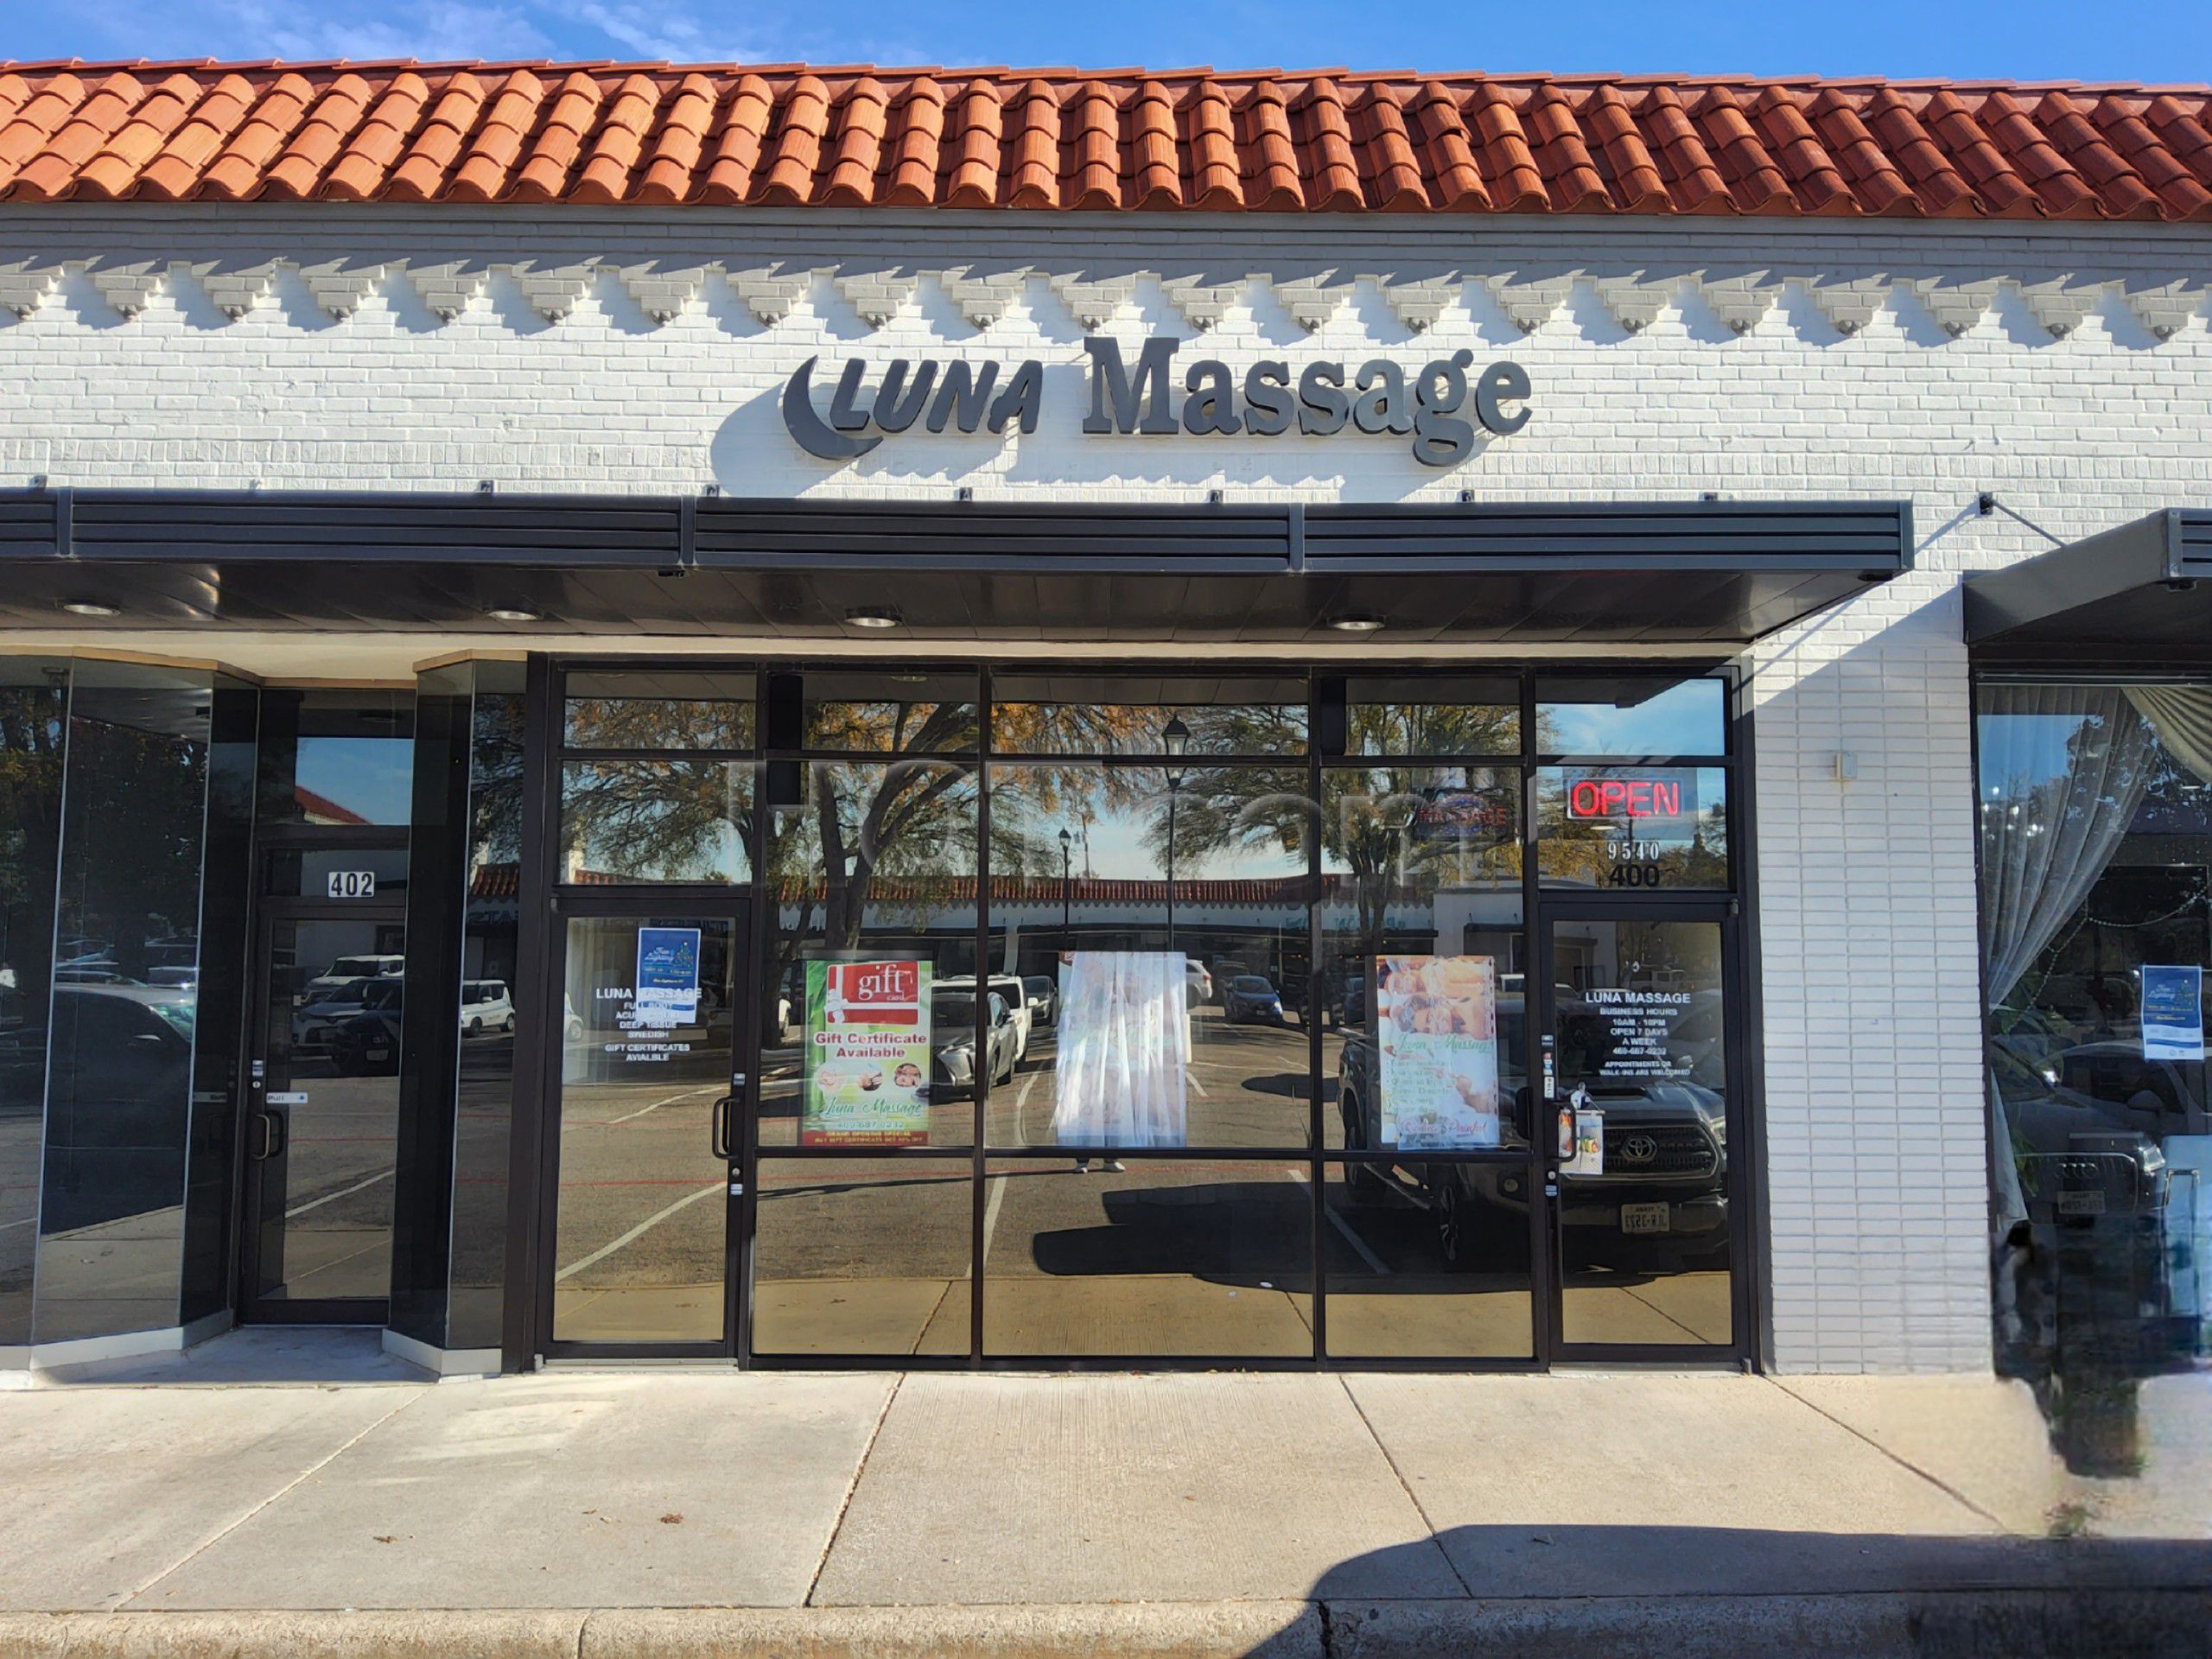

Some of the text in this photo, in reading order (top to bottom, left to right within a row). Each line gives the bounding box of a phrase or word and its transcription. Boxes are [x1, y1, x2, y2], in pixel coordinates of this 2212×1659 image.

[829, 336, 1533, 467] LUNA Massage
[1572, 781, 1678, 817] OPEN
[1607, 842, 1660, 861] 9540
[331, 872, 373, 897] 402
[1609, 864, 1660, 887] 400
[858, 964, 905, 1001] gift
[596, 988, 633, 999] LUNA
[1586, 992, 1691, 1003] LUNA MASSAGE
[815, 1033, 927, 1044] Gift Certificate
[1610, 1027, 1636, 1036] OPEN
[1644, 1027, 1669, 1036] DAYS
[605, 1043, 690, 1052] GIFT CERTIFICATES
[836, 1046, 906, 1058] Available
[862, 1097, 922, 1117] Massage
